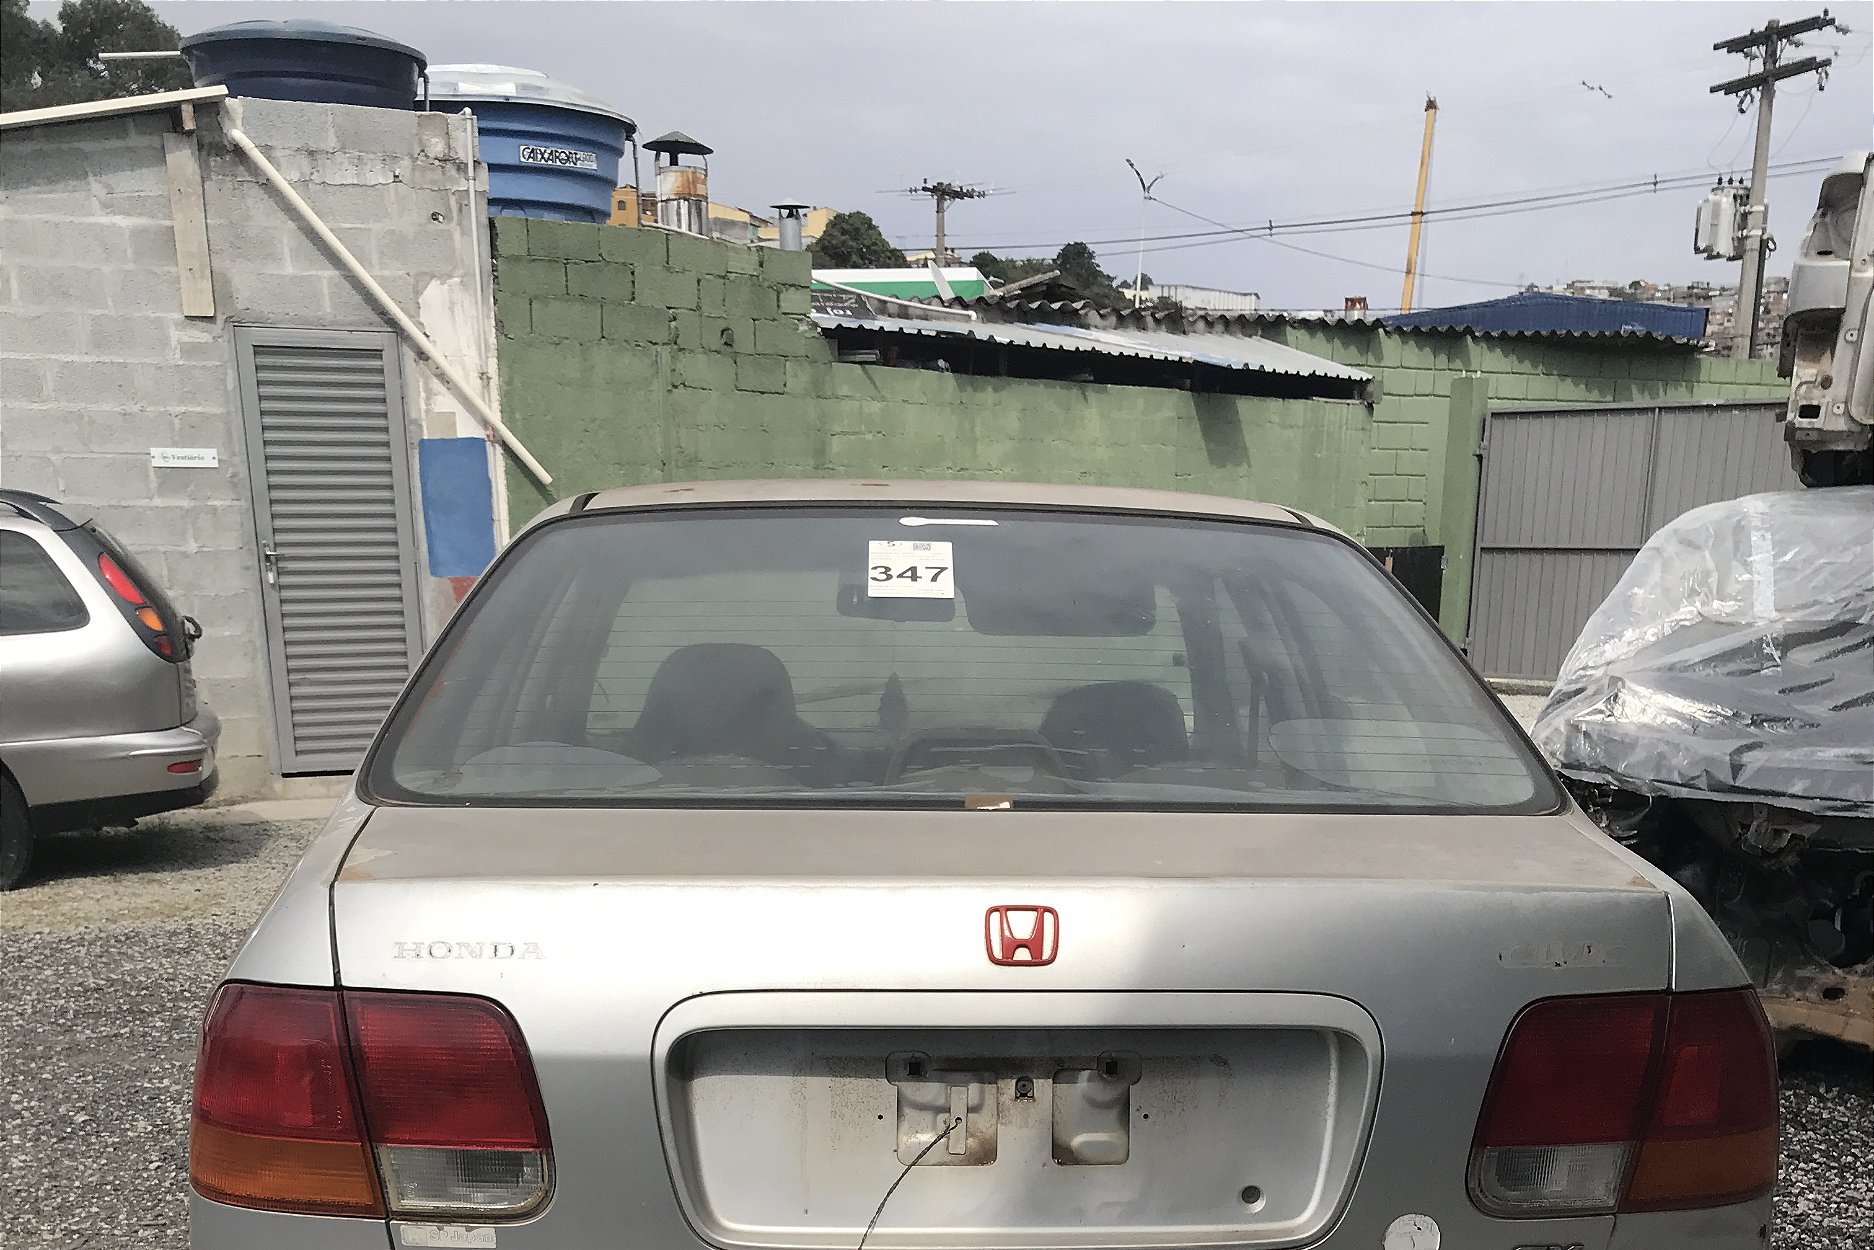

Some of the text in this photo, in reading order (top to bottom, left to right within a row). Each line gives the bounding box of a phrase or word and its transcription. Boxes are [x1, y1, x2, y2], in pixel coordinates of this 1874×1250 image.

[869, 565, 949, 583] 347
[393, 940, 547, 960] HONDA
[451, 1230, 494, 1245] Japan
